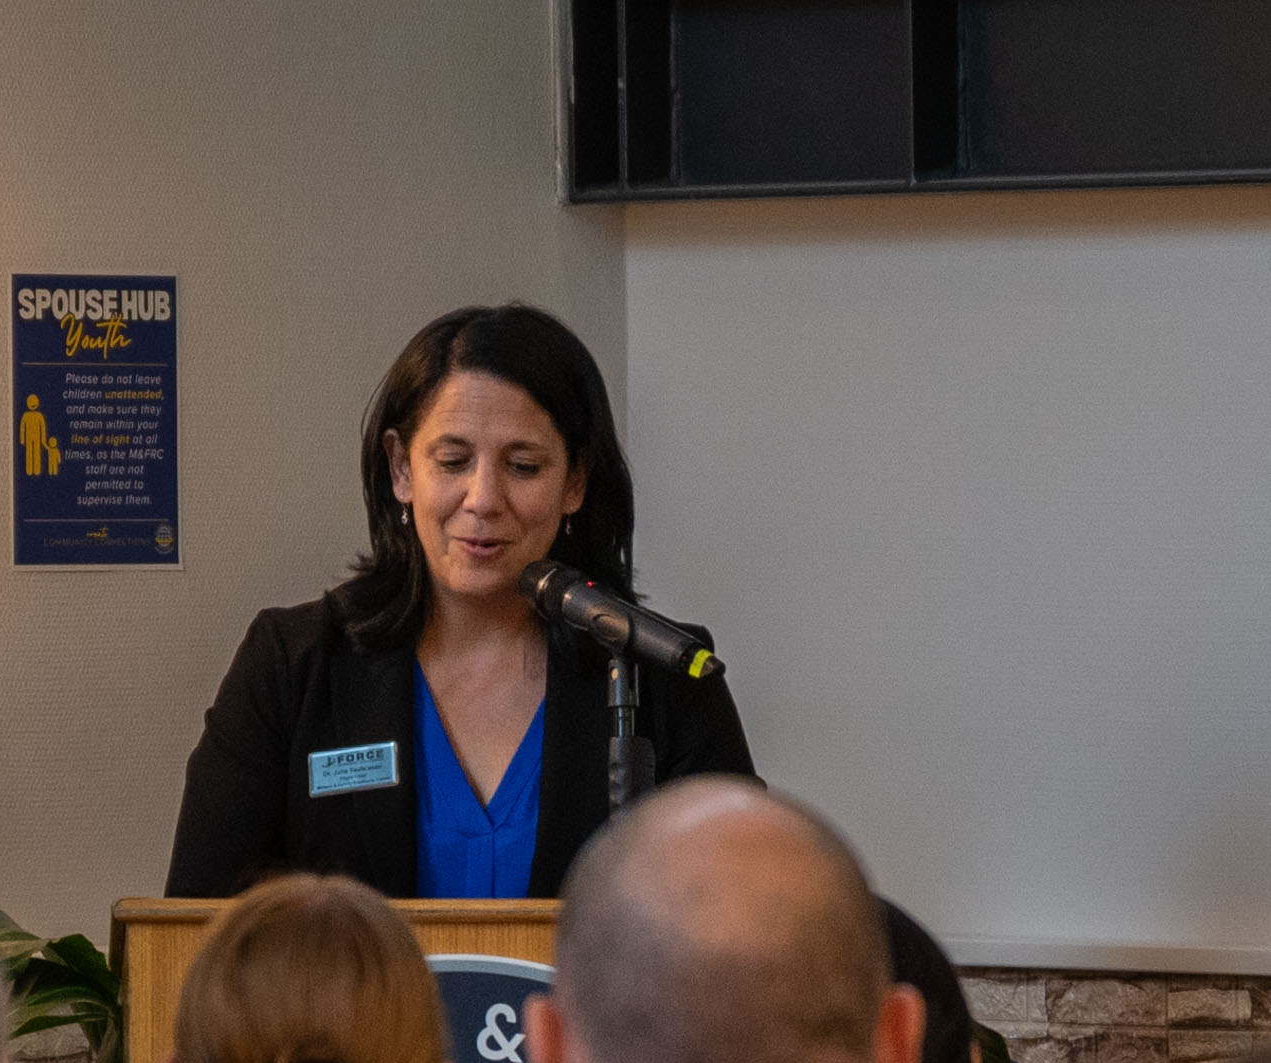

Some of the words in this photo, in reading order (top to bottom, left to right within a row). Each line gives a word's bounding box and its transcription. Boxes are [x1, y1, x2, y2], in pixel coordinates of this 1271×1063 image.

[18, 288, 117, 320] SPOUSE
[121, 290, 171, 320] HUB
[60, 312, 131, 360] Youth
[65, 373, 98, 384] Please
[101, 374, 113, 384] do
[116, 374, 132, 384] not
[135, 374, 161, 384] leave
[62, 389, 102, 399] children
[66, 404, 85, 414] and
[87, 404, 114, 414] make
[116, 405, 138, 414] sure
[140, 404, 162, 416] they
[69, 420, 103, 429] remain
[105, 420, 134, 429] within
[137, 421, 159, 432] your
[70, 434, 90, 444] line
[92, 434, 103, 444] of
[105, 434, 131, 446] sight
[132, 434, 143, 444] at
[145, 434, 158, 444] all
[64, 449, 94, 460] times,
[96, 450, 108, 460] as
[110, 449, 126, 460] the
[128, 448, 164, 460] M&FRC
[85, 464, 108, 475] staff
[109, 466, 125, 475] are
[127, 465, 144, 475] not
[84, 479, 132, 492] permitted
[134, 479, 144, 490] to
[76, 495, 124, 507] supervise
[476, 1003, 525, 1063] &
